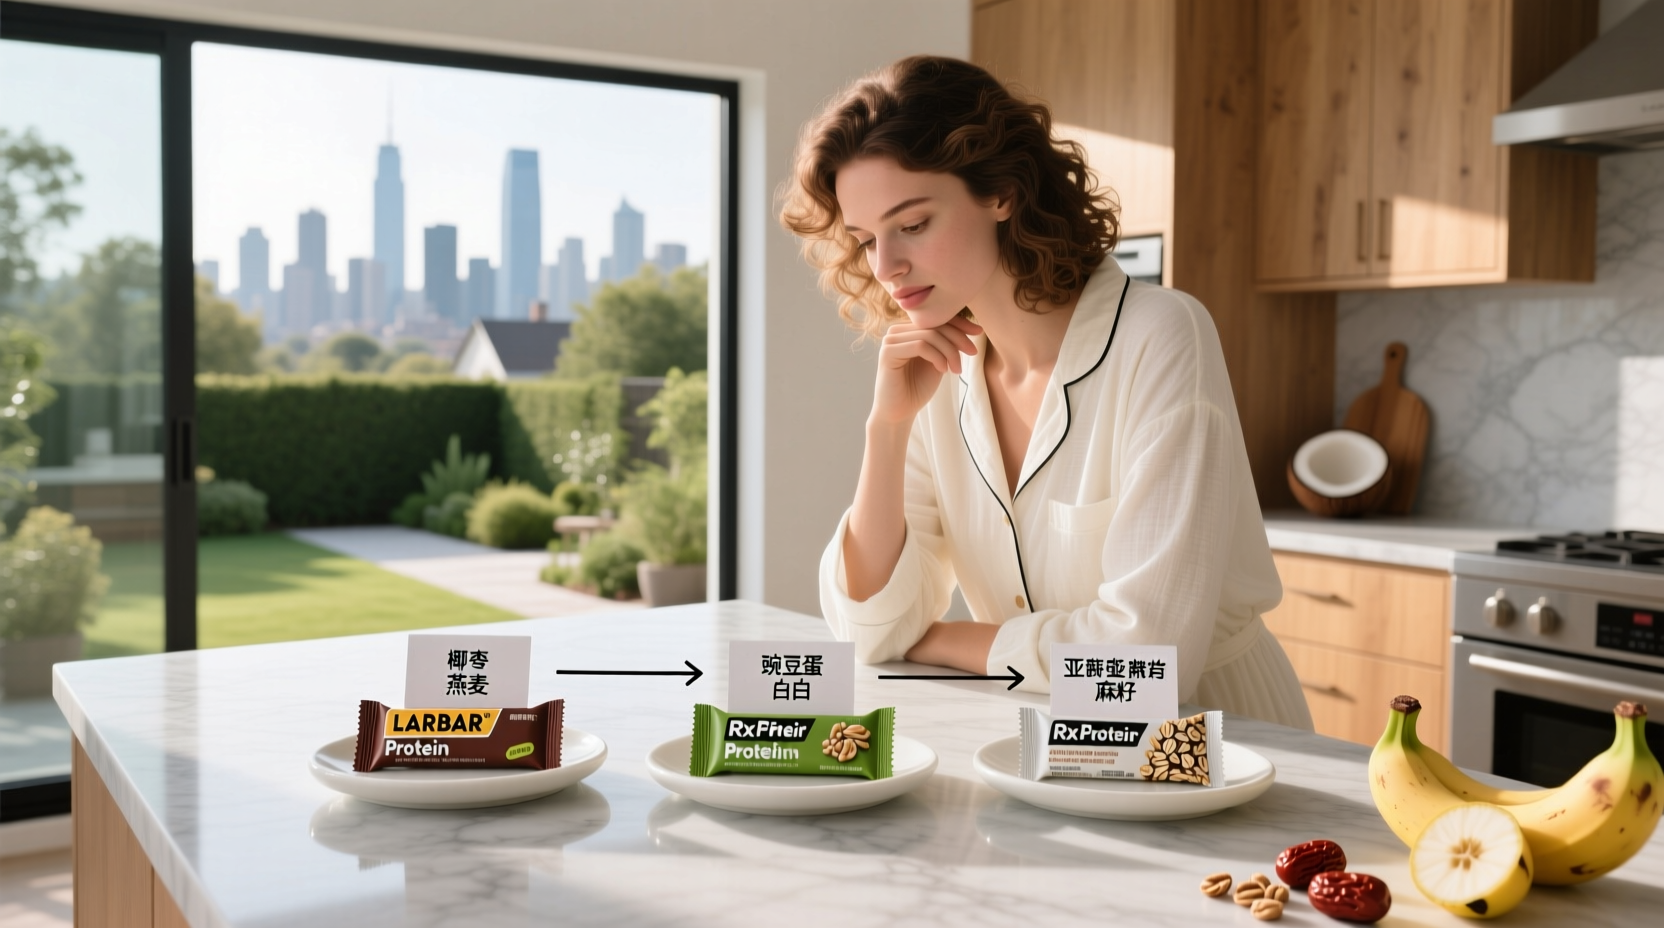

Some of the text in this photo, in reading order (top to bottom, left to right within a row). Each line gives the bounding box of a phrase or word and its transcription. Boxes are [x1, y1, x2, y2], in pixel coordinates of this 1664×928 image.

[761, 654, 823, 676] 豌豆蛋
[446, 673, 489, 695] 燕麦
[773, 678, 810, 700] 白白
[393, 714, 482, 732] LARBAR
[385, 739, 449, 756] Protein
